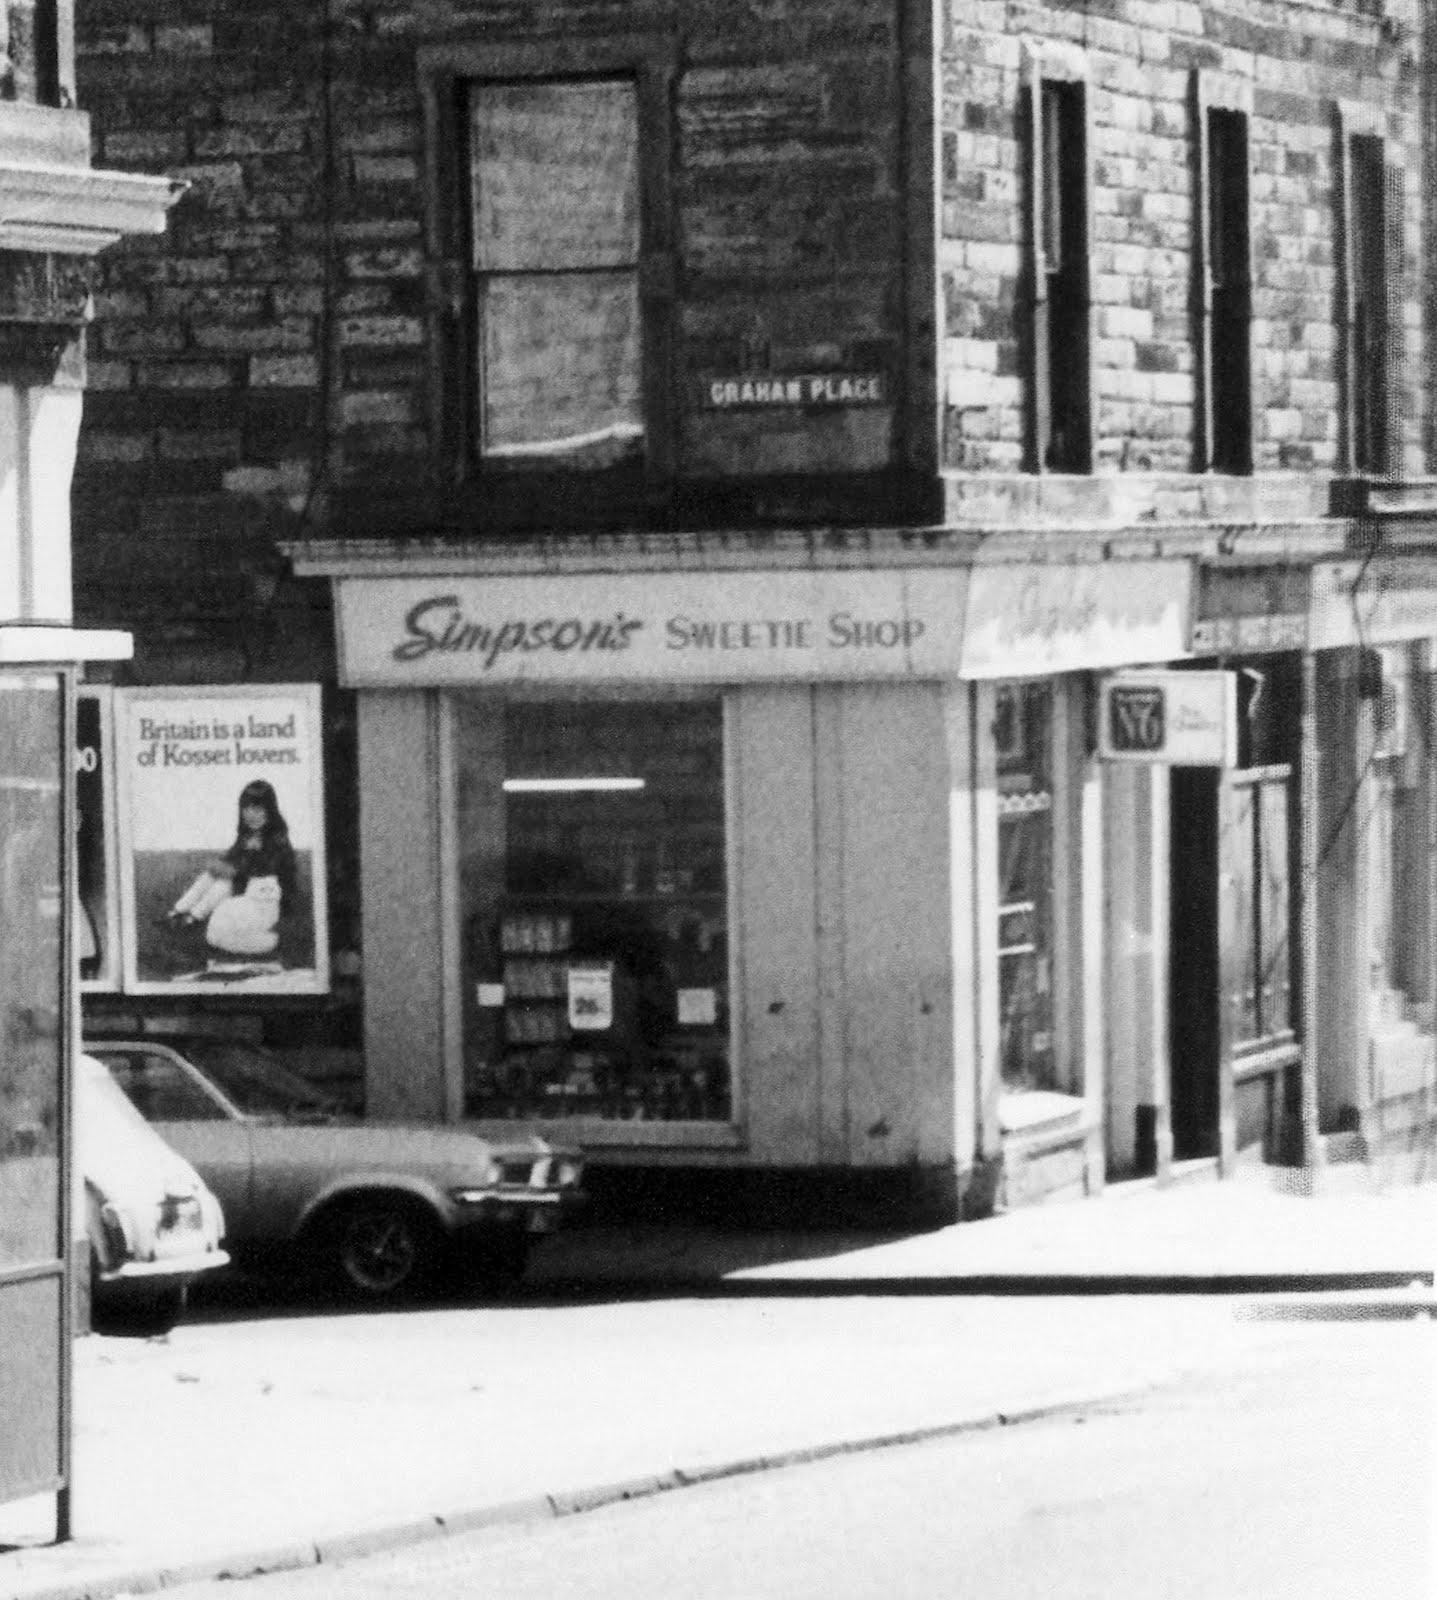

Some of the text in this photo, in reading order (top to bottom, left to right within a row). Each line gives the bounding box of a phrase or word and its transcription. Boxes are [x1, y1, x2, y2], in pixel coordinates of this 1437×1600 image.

[710, 378, 881, 404] GRAHAM PLACE
[392, 596, 645, 668] Simpson's
[827, 612, 925, 650] SHOP
[139, 713, 296, 741] Britain is a land
[137, 742, 158, 767] of
[163, 743, 231, 767] Kosset
